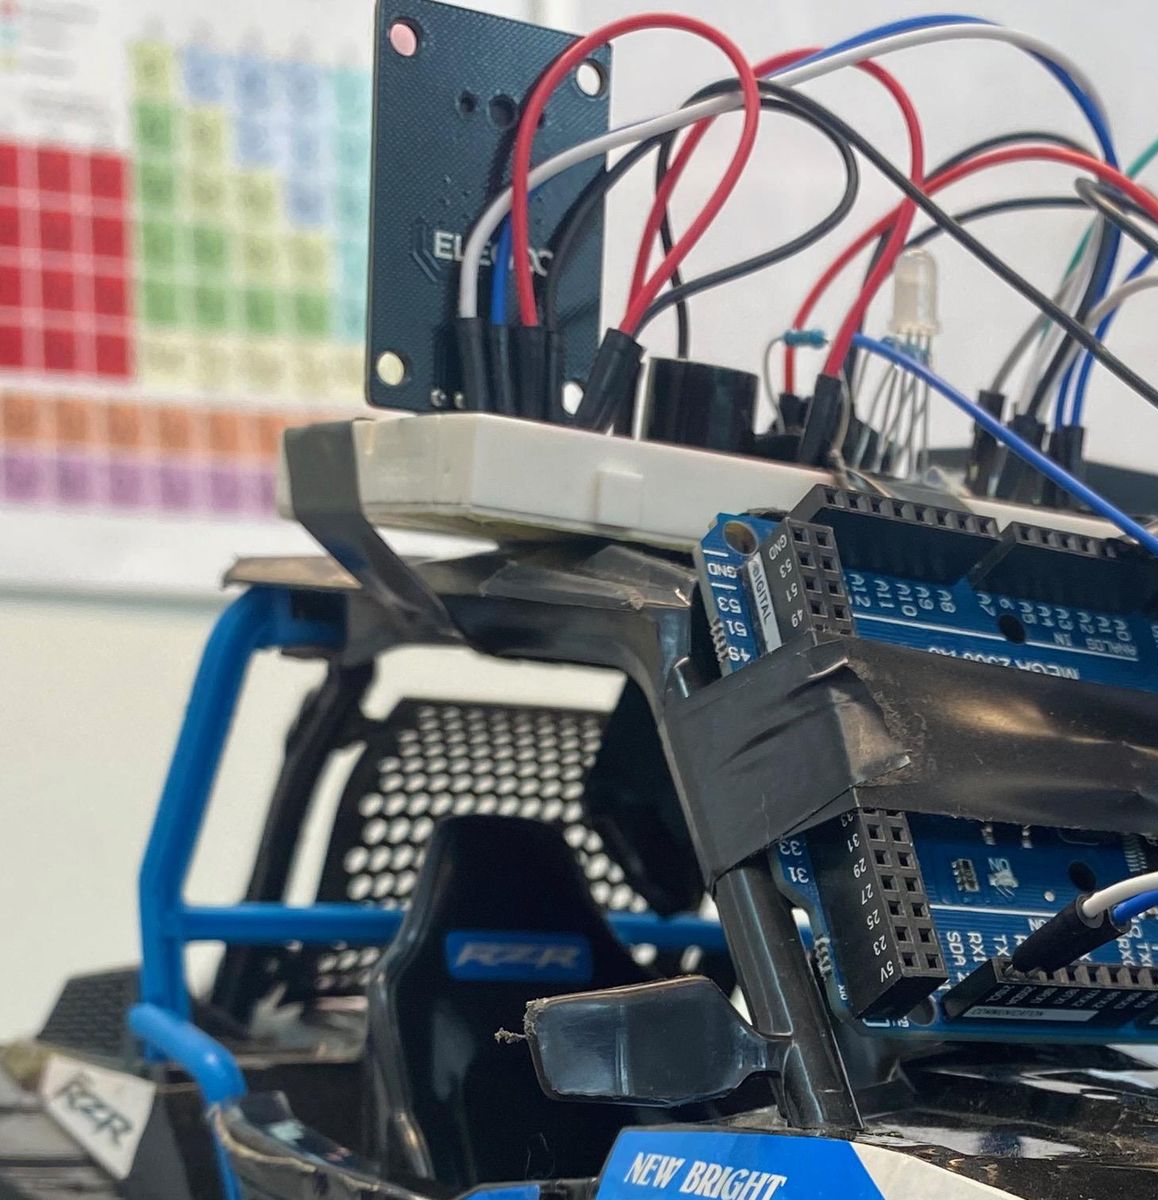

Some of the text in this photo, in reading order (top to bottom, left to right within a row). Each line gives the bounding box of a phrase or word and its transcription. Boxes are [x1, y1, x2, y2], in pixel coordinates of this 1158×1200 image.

[768, 534, 787, 560] GND
[707, 562, 738, 579] GND
[779, 559, 793, 578] 53
[785, 582, 798, 602] 51
[717, 596, 742, 614] 53
[726, 619, 747, 637] 51
[791, 609, 803, 628] 49
[847, 833, 860, 853] 31
[788, 866, 809, 884] 31
[853, 857, 867, 878] 29
[861, 883, 874, 905] 27
[866, 908, 880, 930] 25
[873, 935, 887, 956] 23
[946, 930, 967, 966] SDA
[880, 960, 894, 983] 5V
[54, 1073, 133, 1147] RZR
[623, 1151, 687, 1189] NEW
